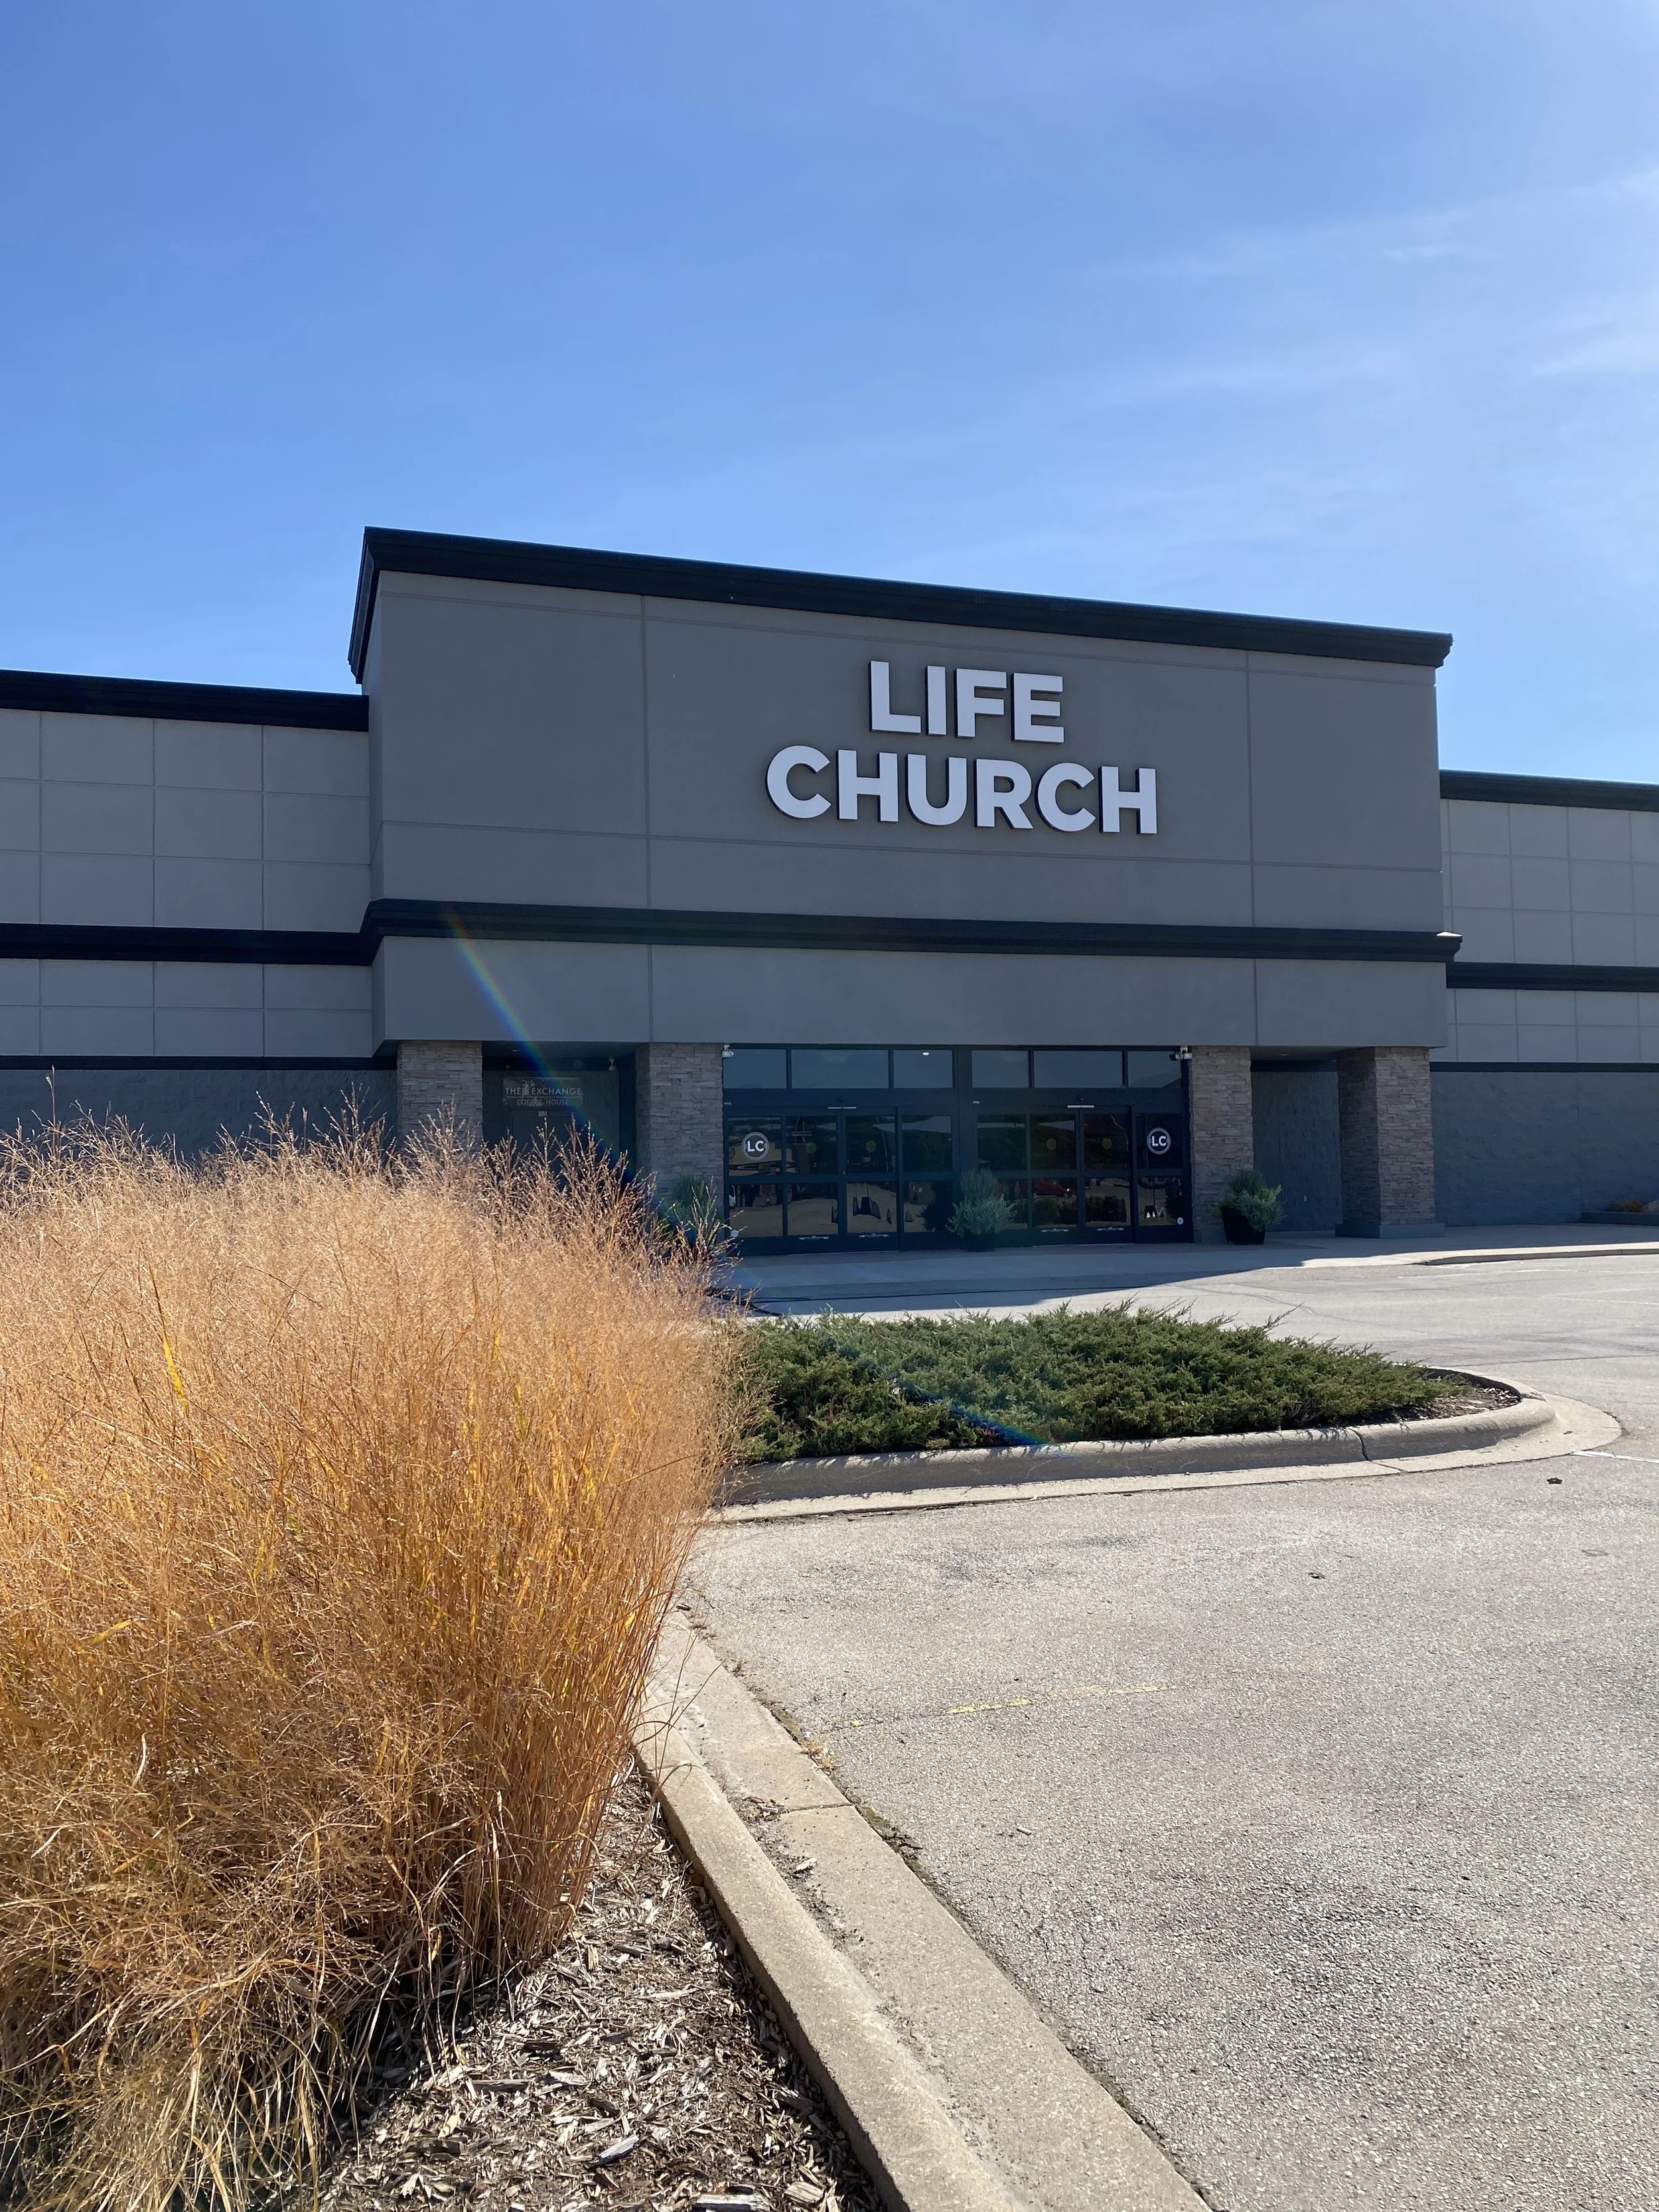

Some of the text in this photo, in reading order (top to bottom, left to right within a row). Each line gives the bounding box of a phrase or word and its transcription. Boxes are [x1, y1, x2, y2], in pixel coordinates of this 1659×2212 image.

[868, 660, 1064, 743] LIFE
[766, 745, 1157, 834] CHURCH
[747, 1140, 764, 1151] LC
[1152, 1136, 1167, 1146] LC
